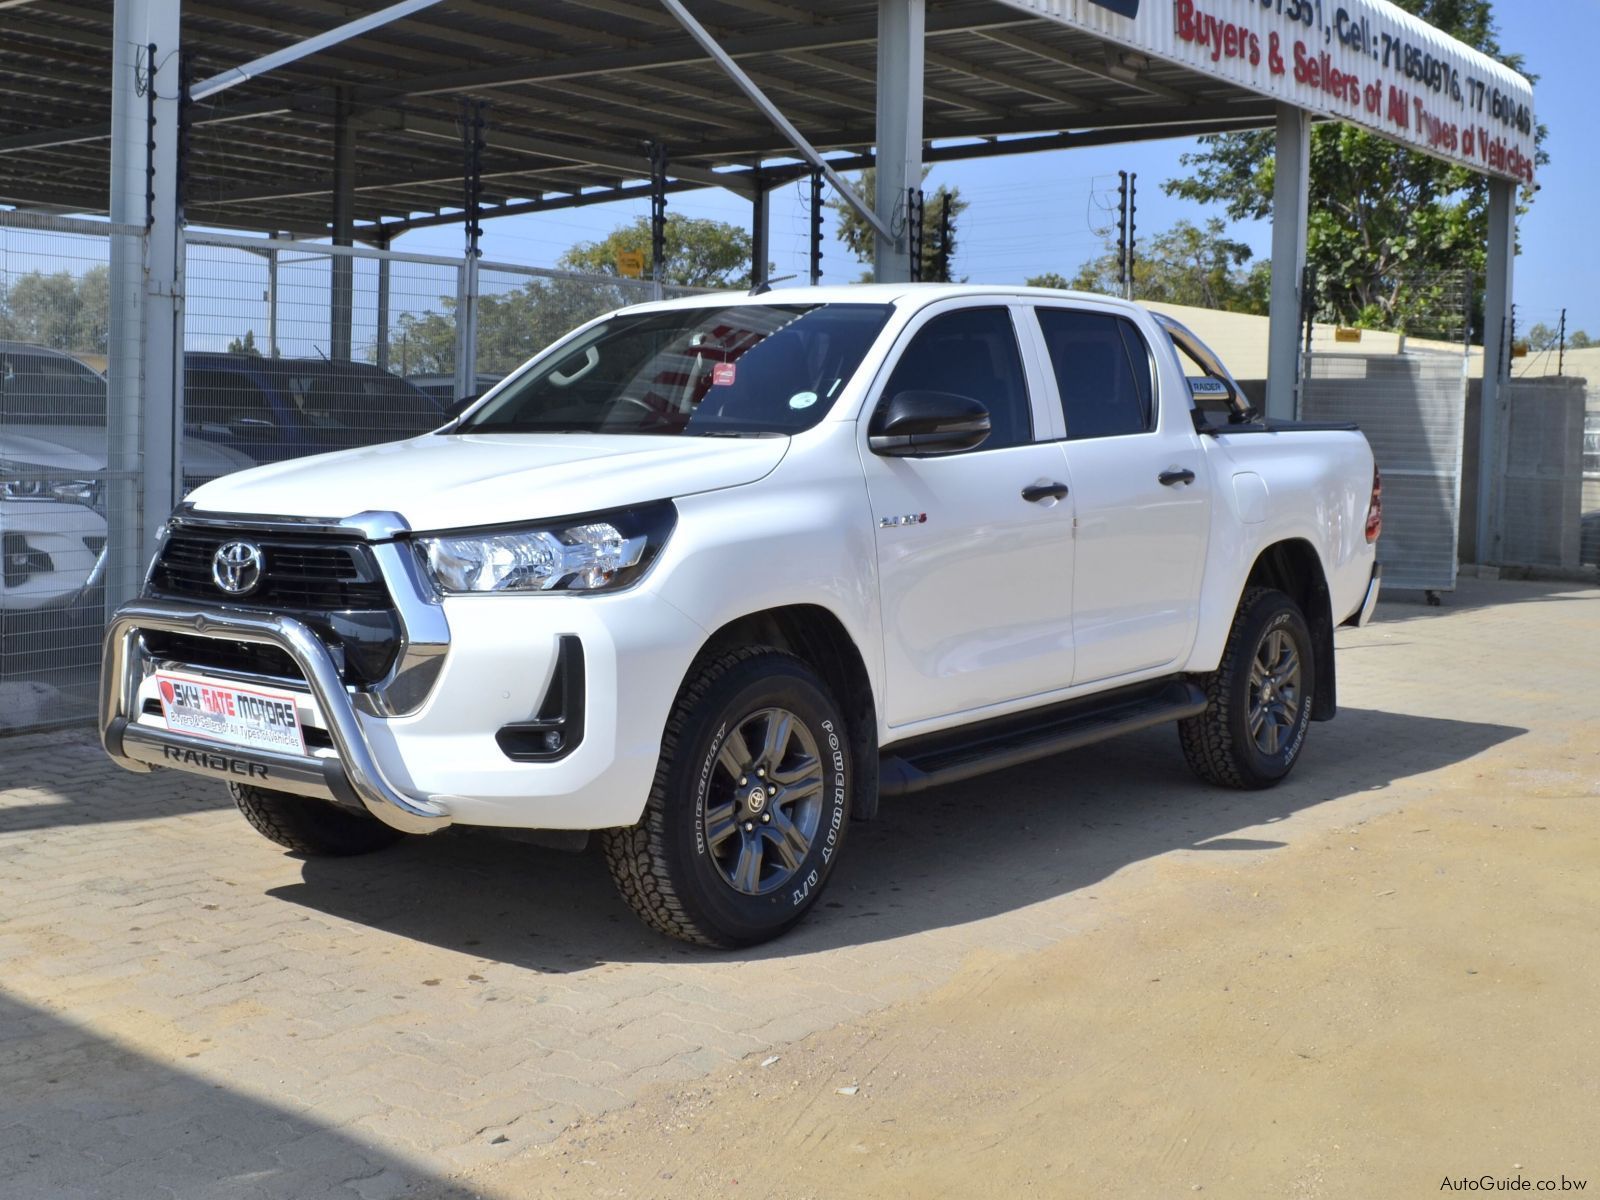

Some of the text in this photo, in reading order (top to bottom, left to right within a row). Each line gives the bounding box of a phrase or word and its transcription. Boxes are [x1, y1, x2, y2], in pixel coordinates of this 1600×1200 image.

[1175, 0, 1533, 183] Buyers & Sellers of All Types of Vehicles
[1193, 383, 1221, 391] RAIDER
[173, 684, 296, 729] SKY GATE MOTORS
[239, 725, 261, 741] Types
[163, 744, 269, 781] RAIDER
[793, 720, 845, 906] POWERWAY A/T
